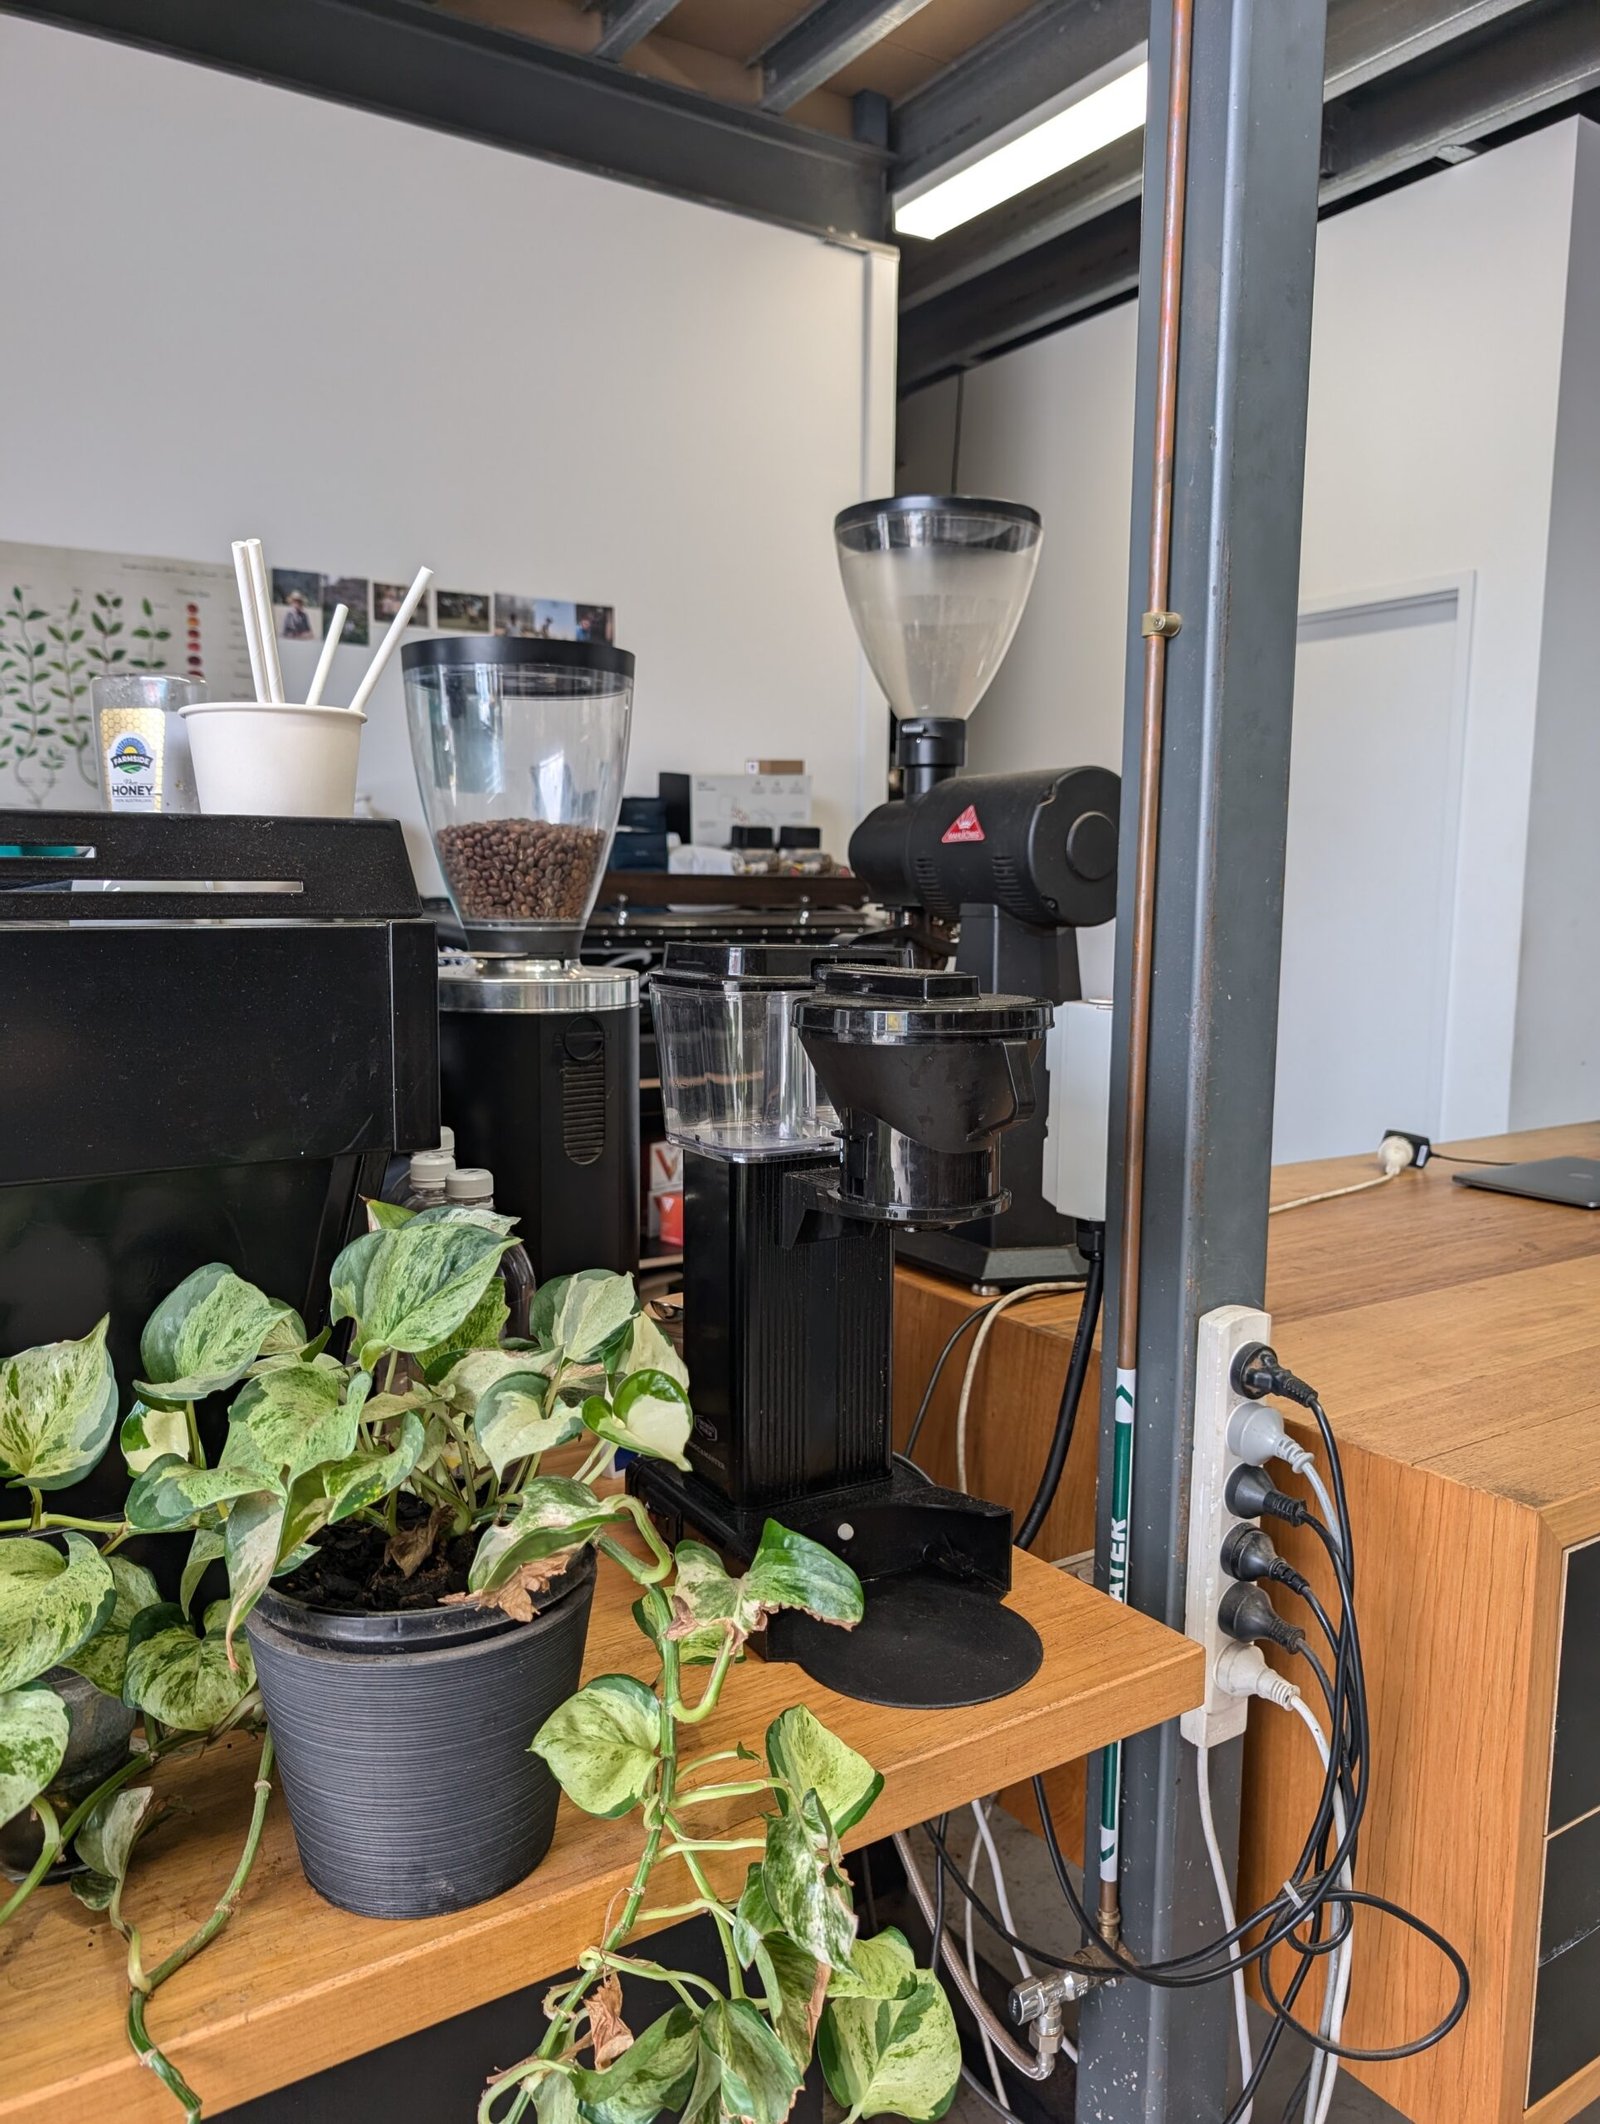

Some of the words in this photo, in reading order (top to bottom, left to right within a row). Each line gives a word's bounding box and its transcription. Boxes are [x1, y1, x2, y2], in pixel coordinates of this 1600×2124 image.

[114, 755, 151, 767] FARMSIDE
[112, 785, 153, 796] HONEY
[1109, 1517, 1126, 1603] ATER
